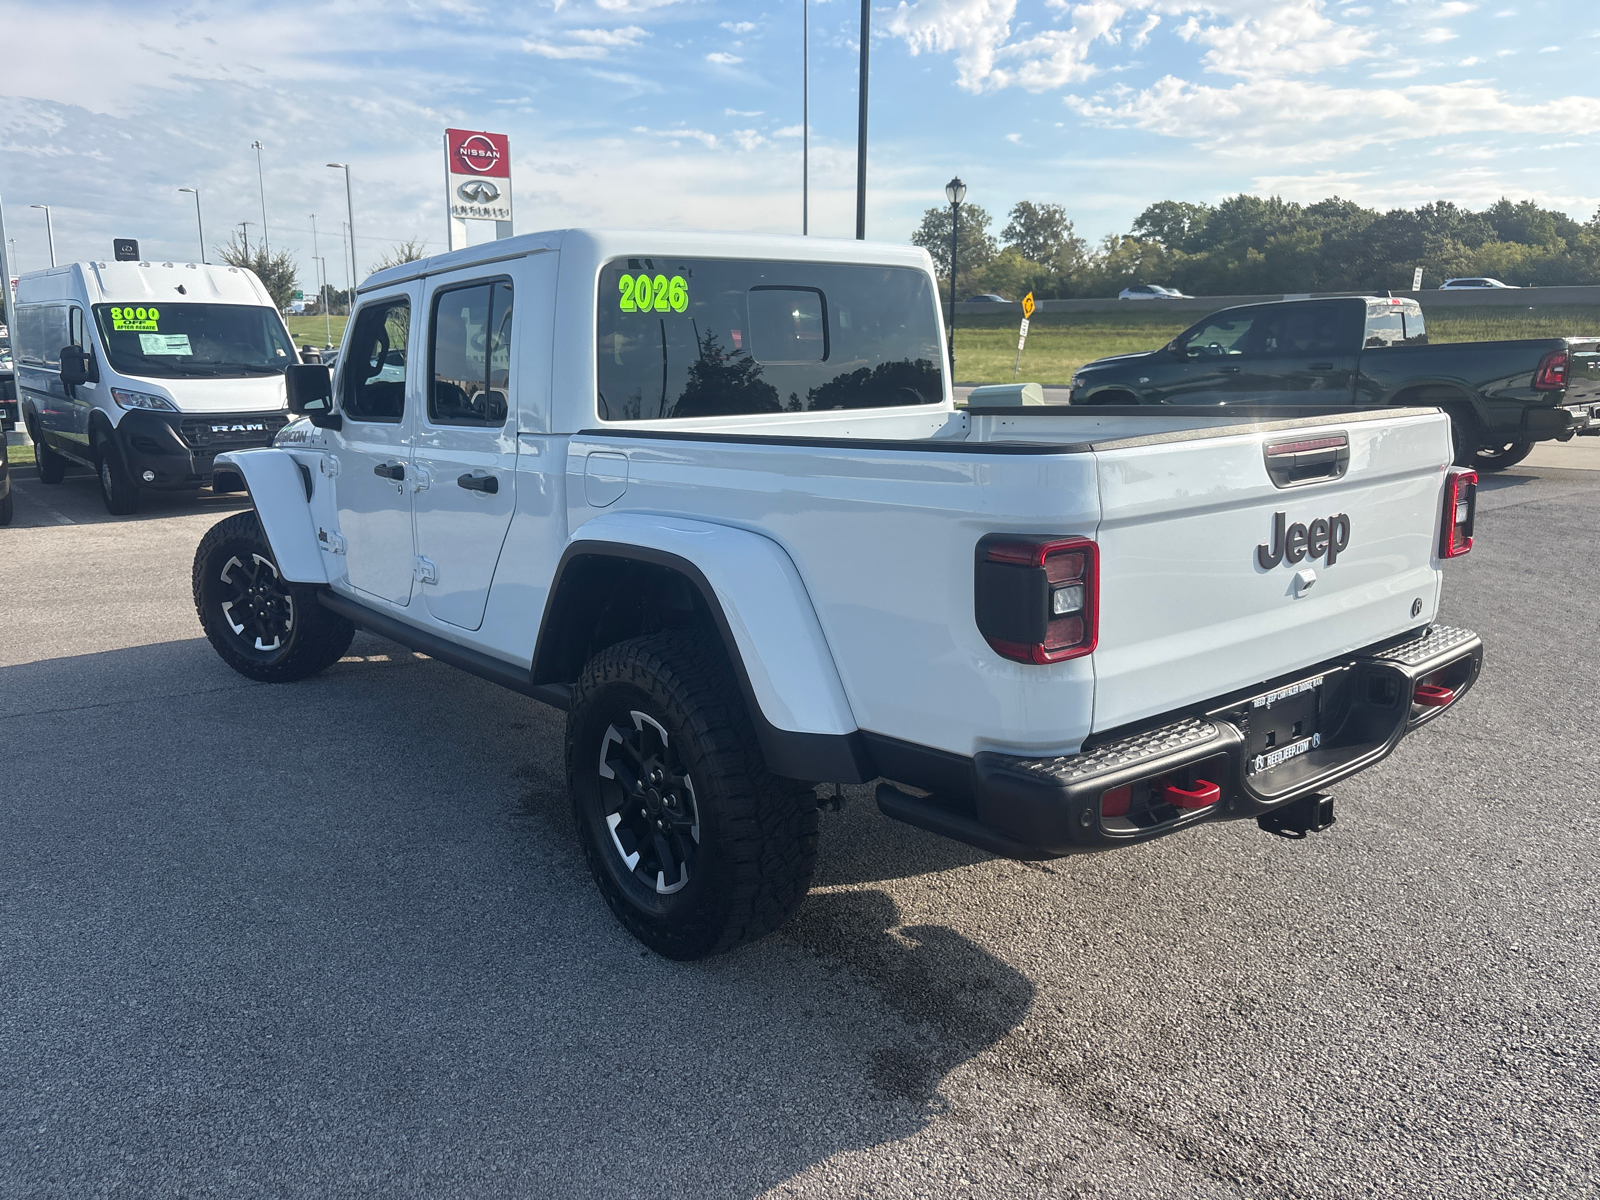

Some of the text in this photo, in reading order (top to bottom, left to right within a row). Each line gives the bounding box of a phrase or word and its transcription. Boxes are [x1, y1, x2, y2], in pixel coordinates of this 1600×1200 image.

[460, 148, 500, 158] NISSAN
[453, 205, 509, 216] INFINITI
[619, 274, 689, 313] 2026
[110, 307, 160, 320] 8000
[211, 424, 263, 432] RAM
[1258, 510, 1350, 569] Jeep
[1267, 740, 1309, 766] REEDJEEP.COM
